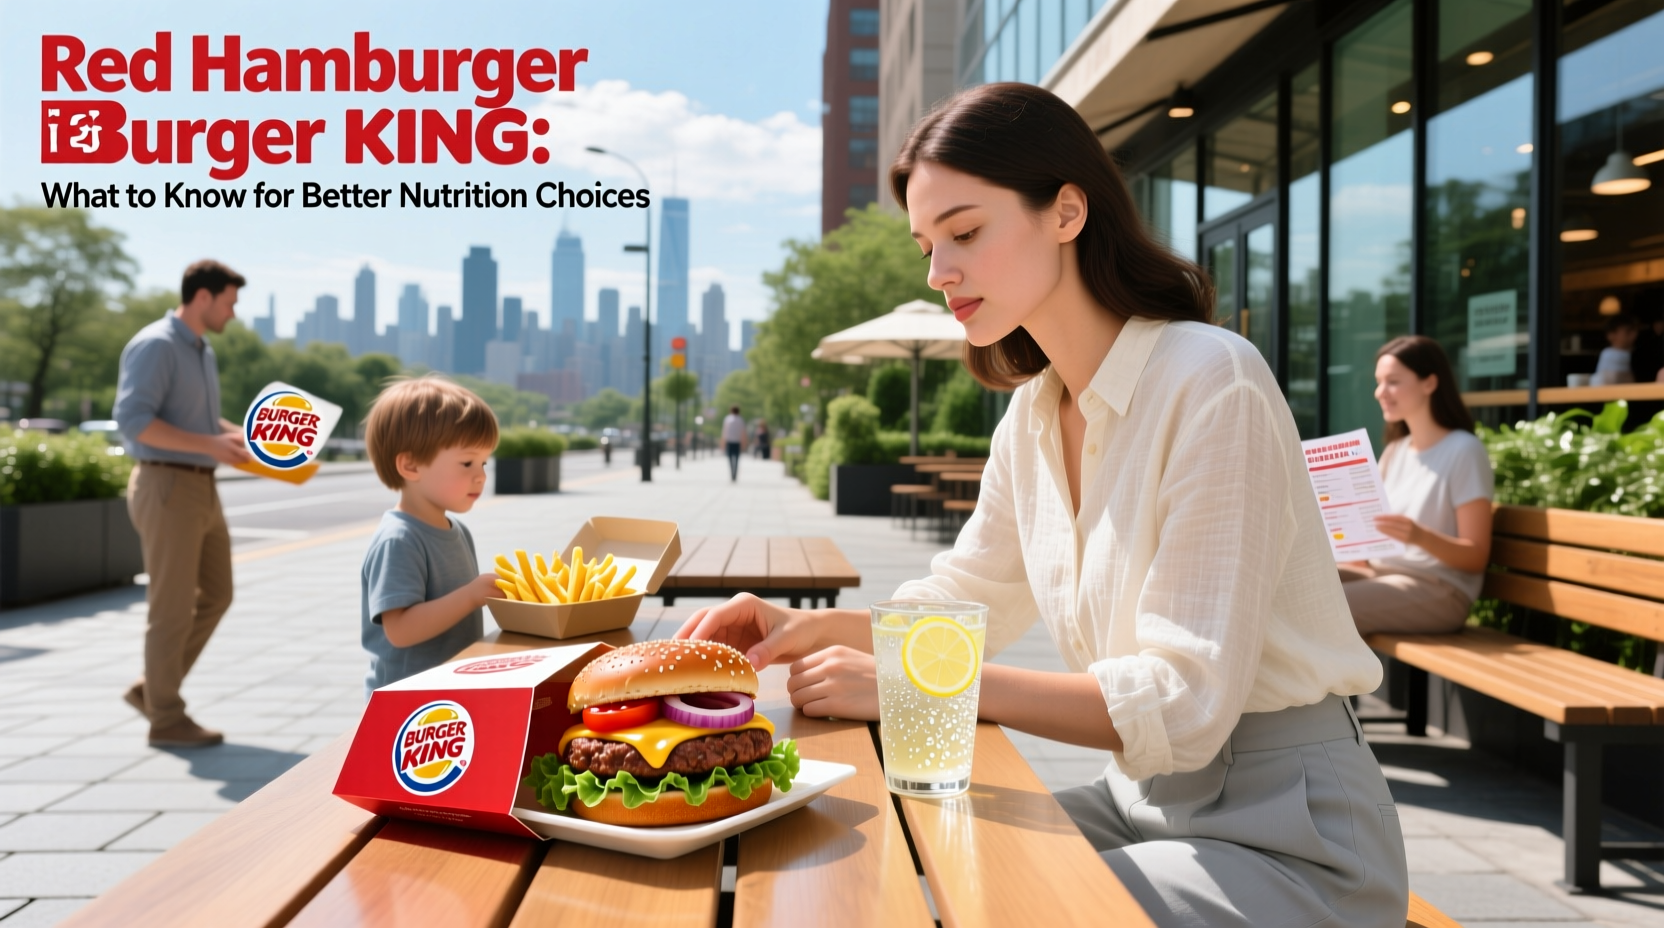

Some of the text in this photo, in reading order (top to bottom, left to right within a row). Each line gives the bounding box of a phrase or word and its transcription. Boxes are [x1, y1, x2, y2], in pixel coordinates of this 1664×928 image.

[256, 407, 321, 429] BURGER
[250, 423, 318, 447] KING
[404, 721, 467, 748] BURGER
[401, 737, 466, 771] KING
